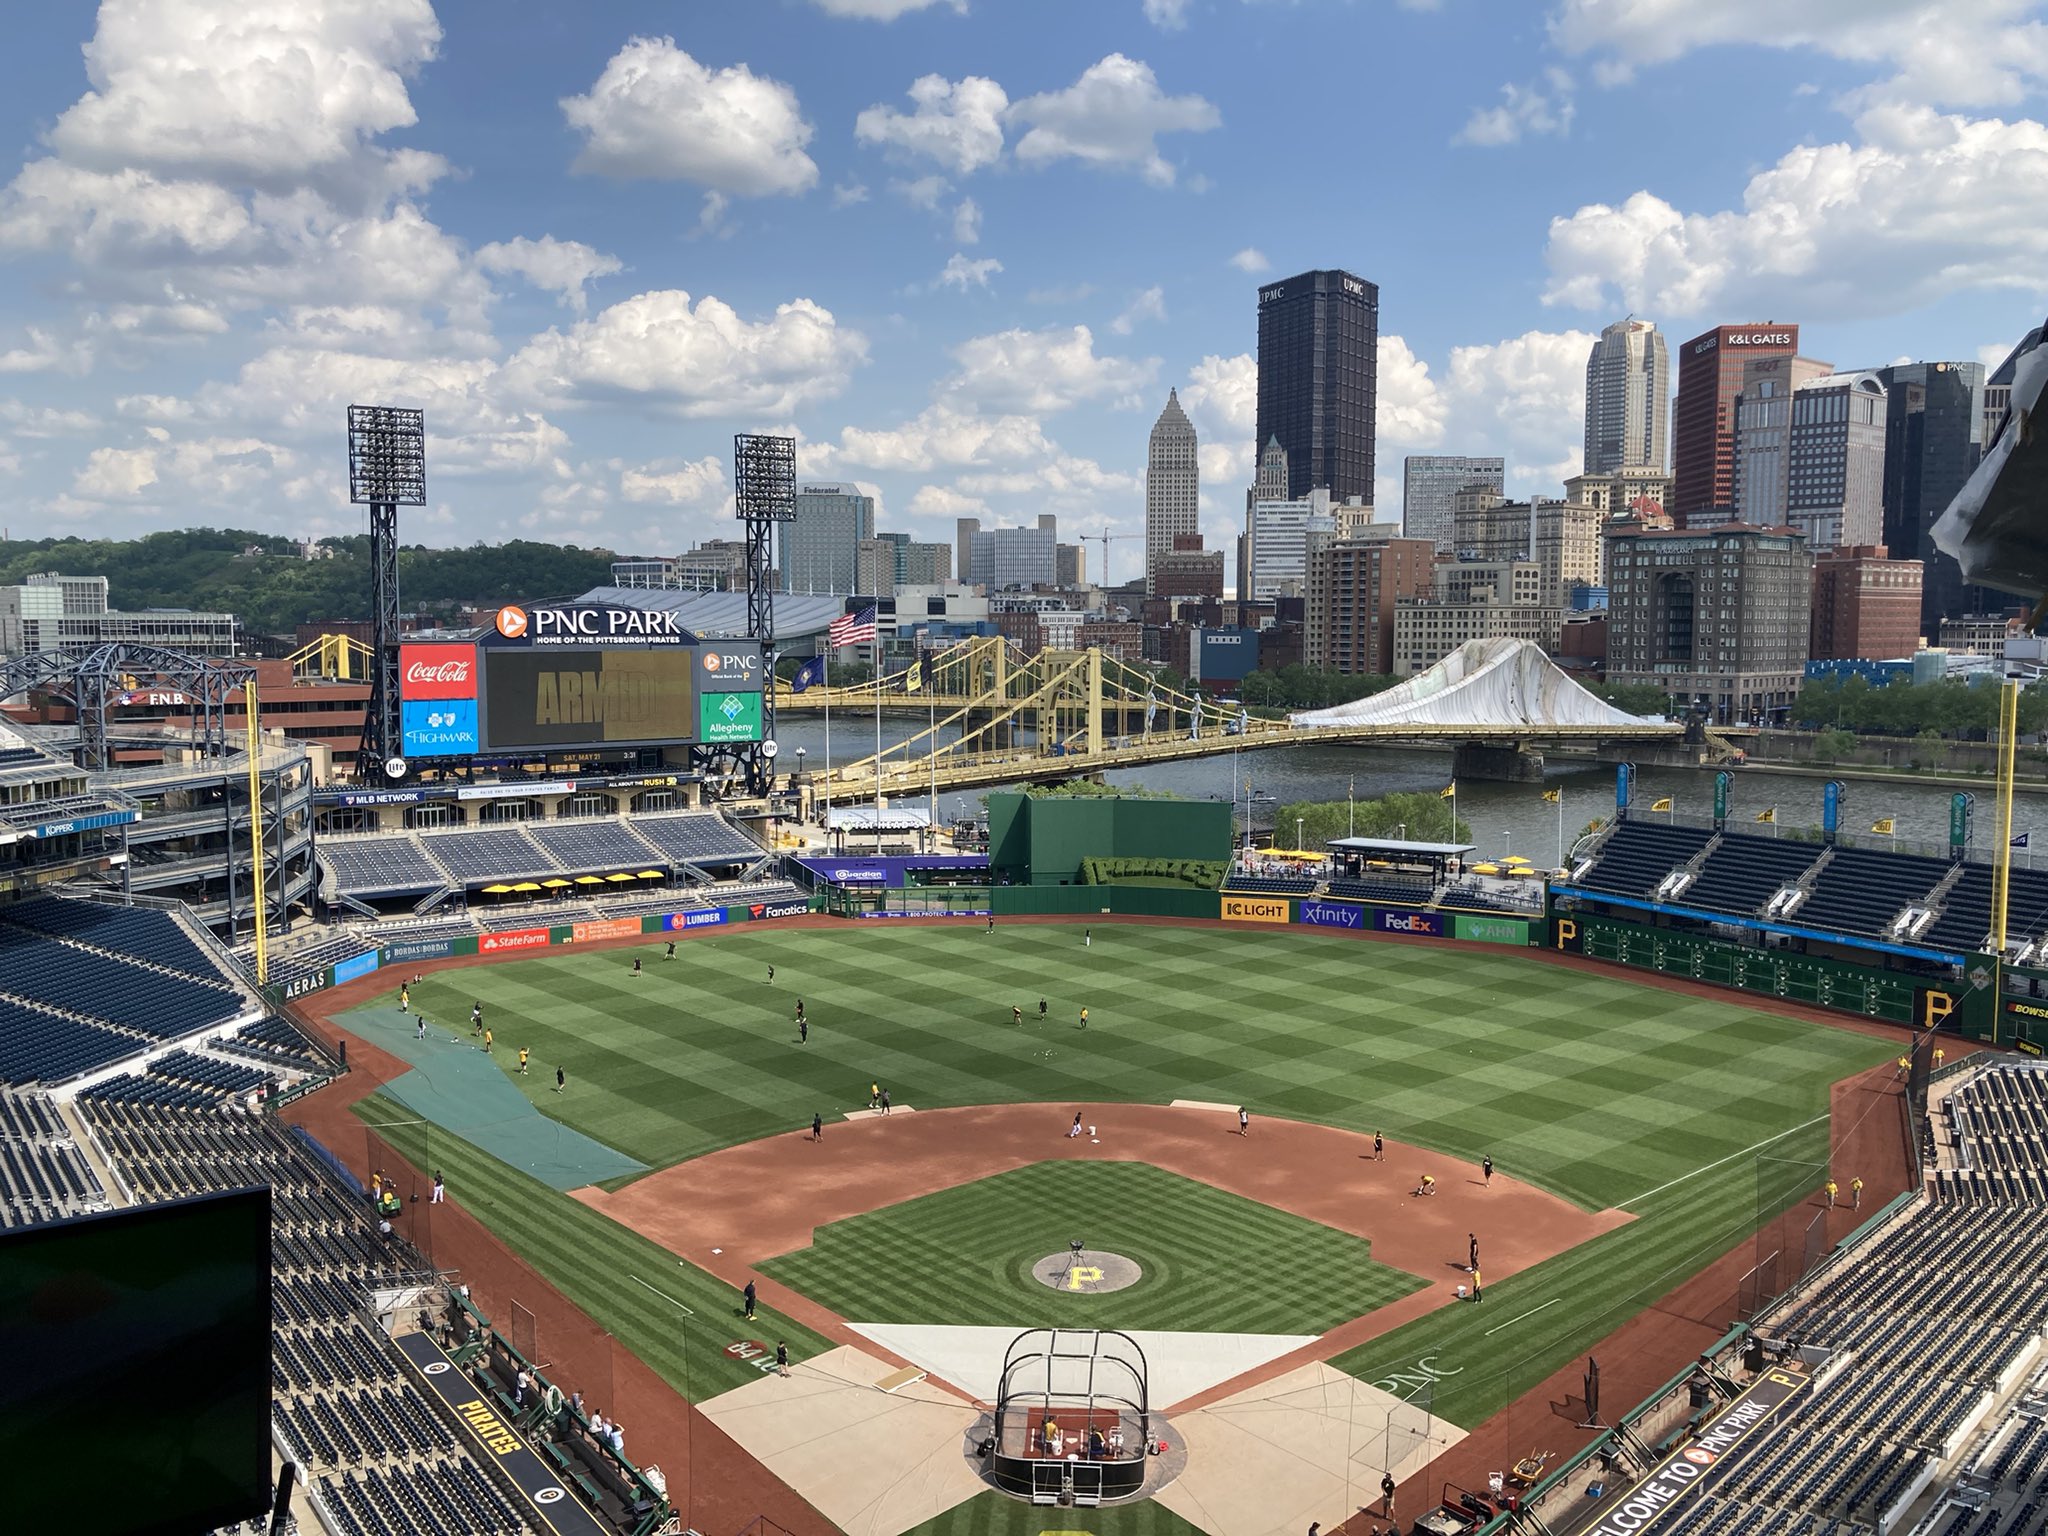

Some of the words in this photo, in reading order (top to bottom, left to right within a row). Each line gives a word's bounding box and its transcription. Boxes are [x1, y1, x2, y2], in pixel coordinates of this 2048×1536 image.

[1344, 279, 1363, 296] UPMC
[1728, 334, 1750, 344] K&L
[1752, 334, 1790, 344] GATES
[1947, 363, 1967, 372] PNC
[533, 609, 599, 635] PNC
[606, 609, 682, 635] PARK
[722, 655, 757, 669] PNC
[407, 661, 471, 682] Coca-Cola
[743, 672, 750, 681] P
[150, 693, 186, 705] F.N.B.
[709, 724, 753, 734] Allegheny
[408, 731, 474, 743] HIGHMARK
[764, 744, 776, 753] Lite
[388, 763, 404, 773] Lite
[644, 779, 664, 787] RUSH
[356, 796, 374, 804] MLB
[376, 793, 418, 802] NETWORK
[46, 822, 74, 835] KOPPERS
[855, 821, 873, 829] FAT
[1095, 857, 1223, 887] PIRATES
[766, 905, 808, 918] Fanatics
[1227, 903, 1242, 915] IC
[1244, 904, 1284, 917] LIGHT
[1306, 905, 1358, 926] xfinity
[673, 916, 685, 927] 84
[687, 913, 720, 925] LUMBER
[1385, 914, 1430, 932] FedEx
[1486, 924, 1516, 938] AHN
[1558, 919, 1577, 949] P
[1596, 924, 1657, 941] NATIONAL
[1669, 938, 1718, 953] LEAGUE
[1708, 940, 1732, 950] WELCOME
[394, 945, 420, 956] BORDAS
[423, 942, 449, 953] BORDAS
[1748, 953, 1824, 973] AMERICAN
[1838, 970, 1898, 987] LEAGUE
[286, 972, 325, 999] AERAS
[1925, 990, 1953, 1028] P
[2019, 1042, 2041, 1056] BOWSER
[1067, 1266, 1105, 1290] P
[1769, 1373, 1796, 1388] P
[457, 1400, 523, 1456] PIRATES
[1659, 1462, 1699, 1485] TO
[1697, 1427, 1741, 1456] PNC
[1727, 1398, 1770, 1431] PARK
